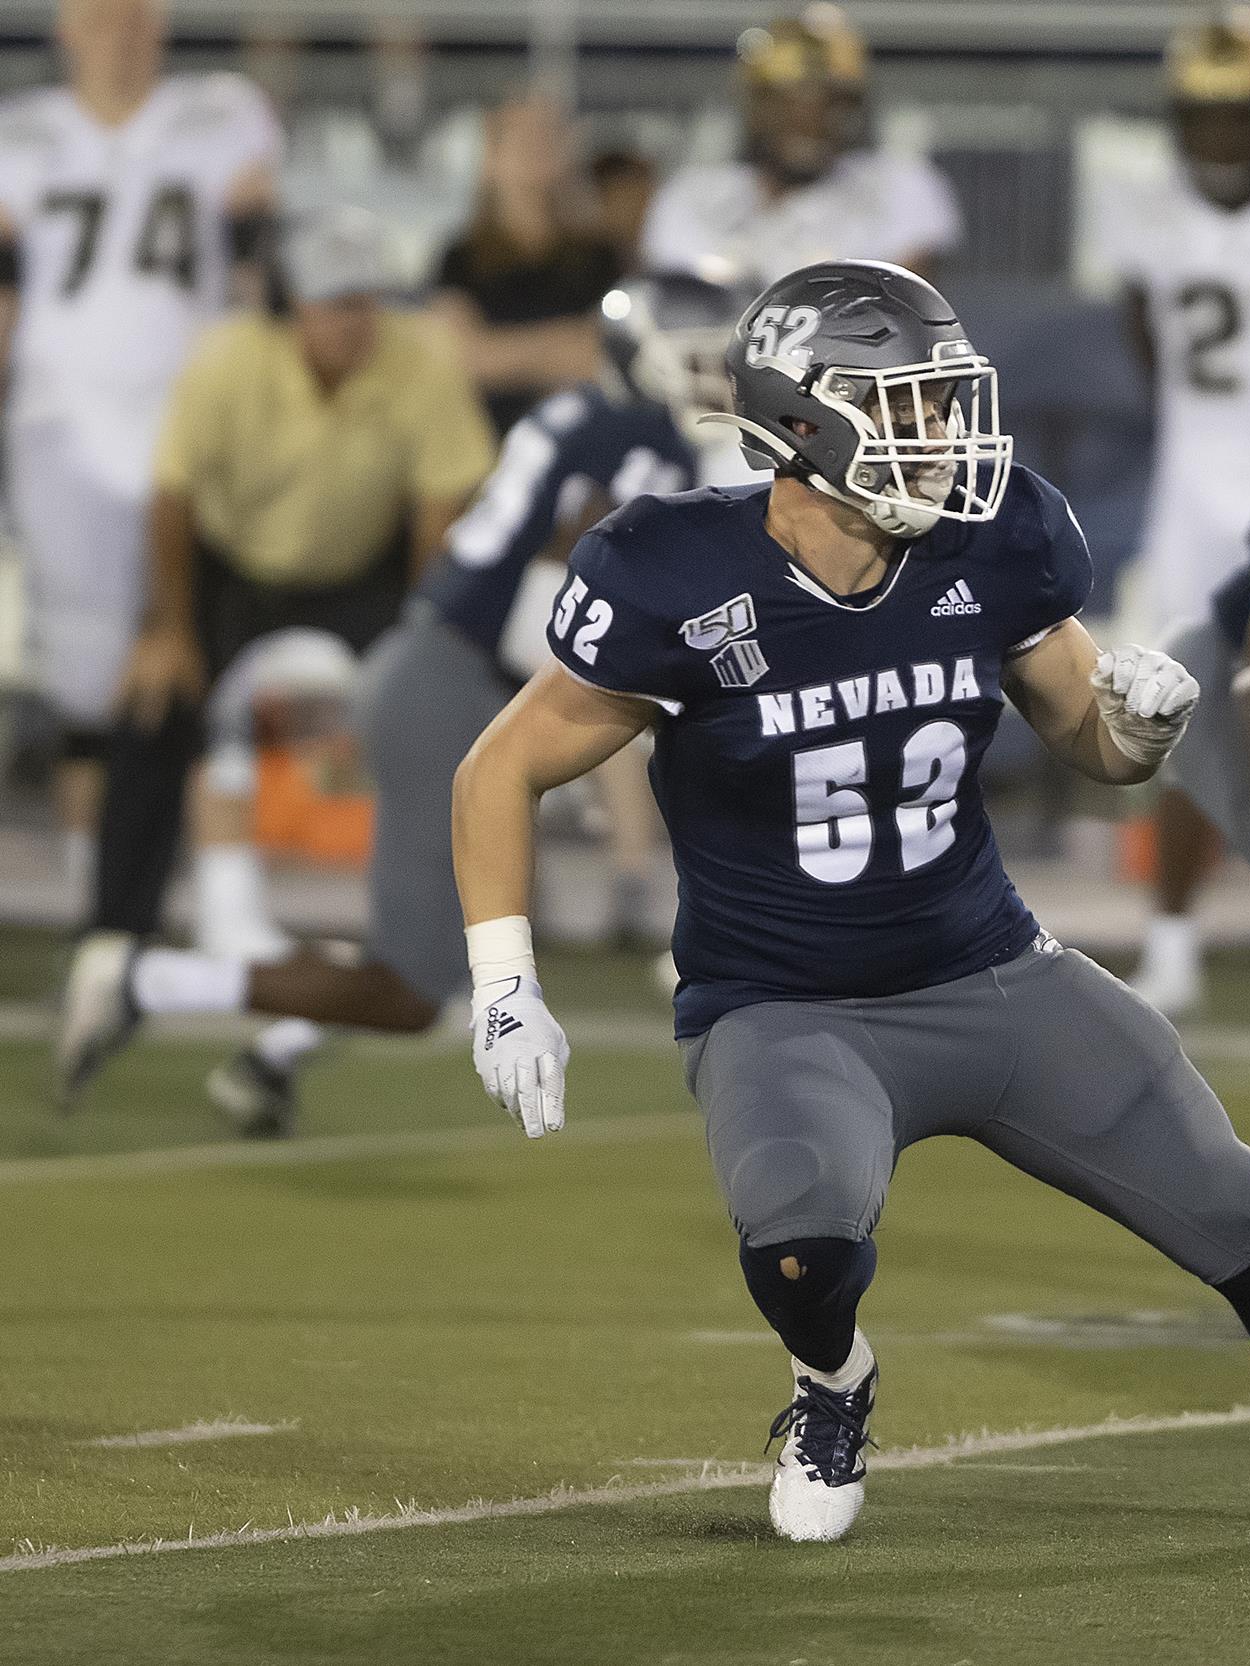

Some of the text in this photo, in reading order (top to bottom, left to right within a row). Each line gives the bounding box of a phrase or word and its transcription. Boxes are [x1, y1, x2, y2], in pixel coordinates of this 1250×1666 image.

[42, 178, 200, 299] 74
[745, 305, 821, 369] 52
[554, 574, 614, 667] 52
[930, 601, 982, 617] adidas
[757, 657, 981, 736] NEVADA
[792, 718, 968, 885] 52
[484, 1007, 501, 1052] adidas
